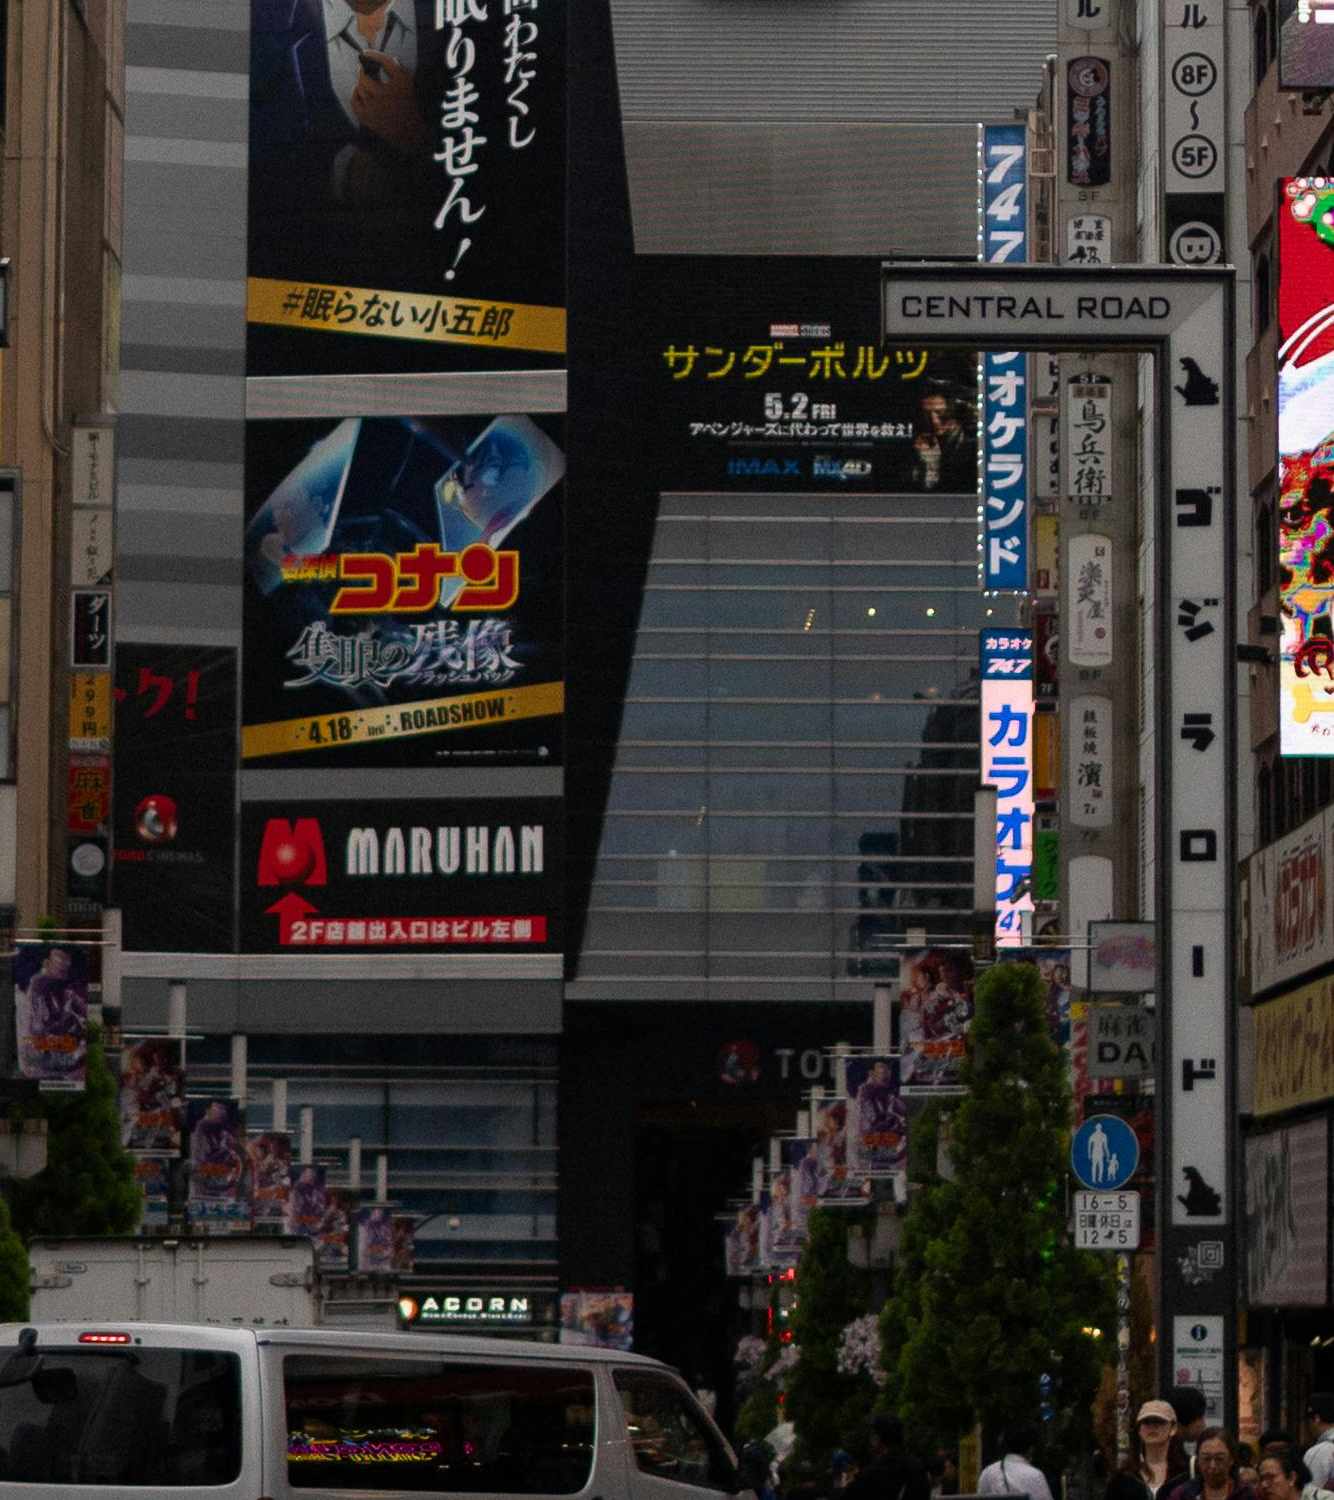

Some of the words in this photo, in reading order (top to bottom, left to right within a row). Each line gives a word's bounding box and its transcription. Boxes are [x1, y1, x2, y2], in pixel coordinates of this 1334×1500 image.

[1180, 60, 1210, 86] 8F
[1180, 144, 1210, 169] 5F
[986, 144, 1026, 262] 747
[282, 286, 515, 340] #眠らない小五郎
[901, 295, 1066, 321] CENTRAL
[1076, 295, 1172, 320] ROAD
[663, 341, 929, 380] サンダーボルツ
[764, 391, 809, 421] 5.2
[812, 403, 837, 420] FRI
[727, 458, 801, 475] IMAX
[328, 542, 520, 614] コナン
[985, 636, 1033, 651] カラオケ
[986, 658, 1033, 674] 747
[307, 716, 354, 744] 4.18
[399, 696, 506, 732] ROADSHOW
[987, 703, 1031, 903] カラオケ
[1176, 486, 1222, 1092] ゴジラロード
[345, 825, 545, 876] MARUHAN
[289, 918, 534, 942] 2F店舗出入口はビル左側
[422, 1296, 529, 1313] ACORN
